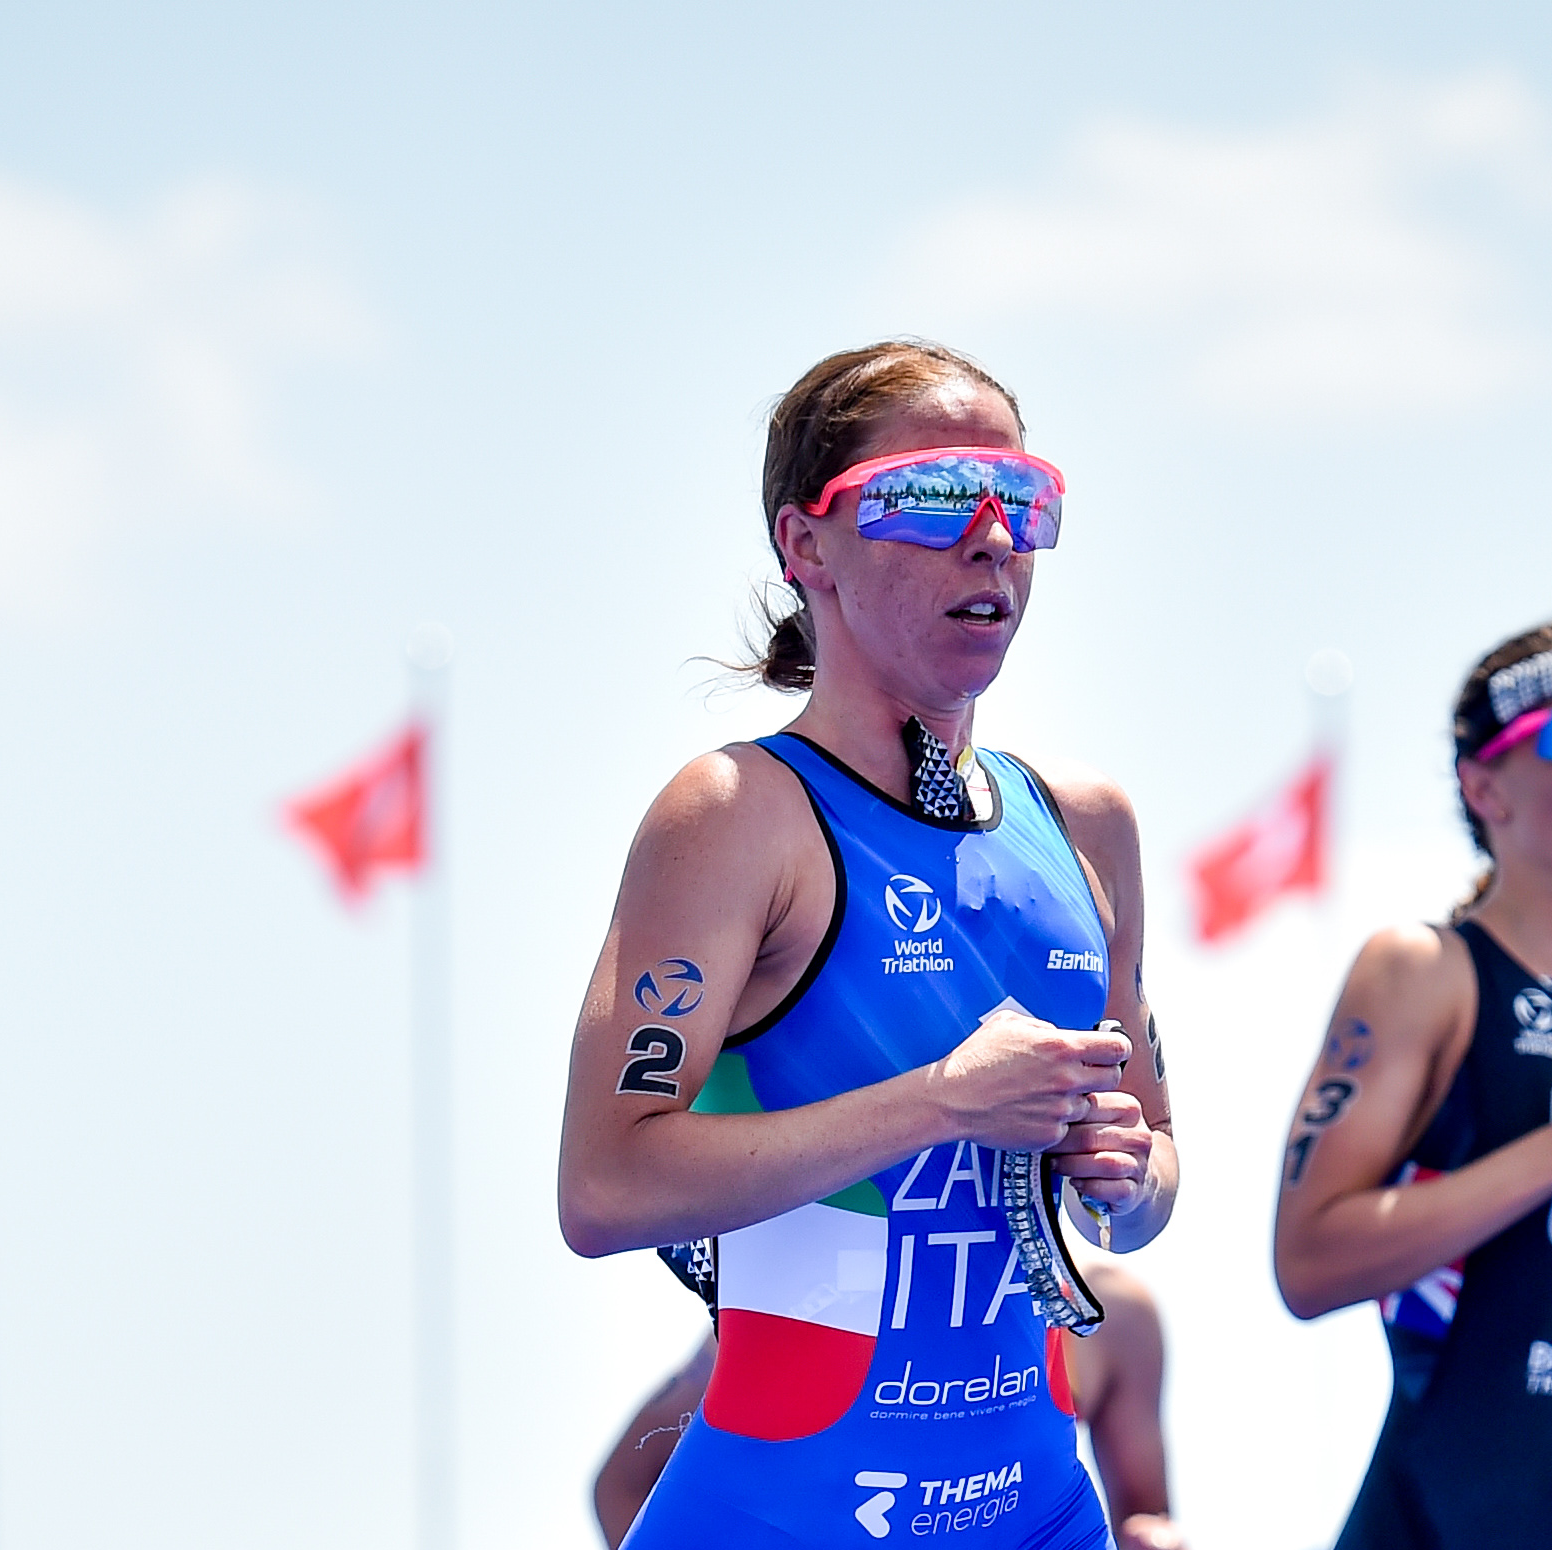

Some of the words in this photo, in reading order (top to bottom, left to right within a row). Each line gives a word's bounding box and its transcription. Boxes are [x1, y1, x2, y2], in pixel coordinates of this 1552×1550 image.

[894, 938, 943, 956] World
[1046, 949, 1104, 973] Santini
[881, 956, 954, 975] Triathlon
[615, 1024, 686, 1099] 2
[874, 1354, 1039, 1406] dorelan
[869, 1409, 929, 1421] dormire
[934, 1409, 966, 1421] bene
[970, 1403, 1006, 1417] vivere
[919, 1461, 1023, 1506] THEMA
[910, 1488, 1020, 1536] energia
